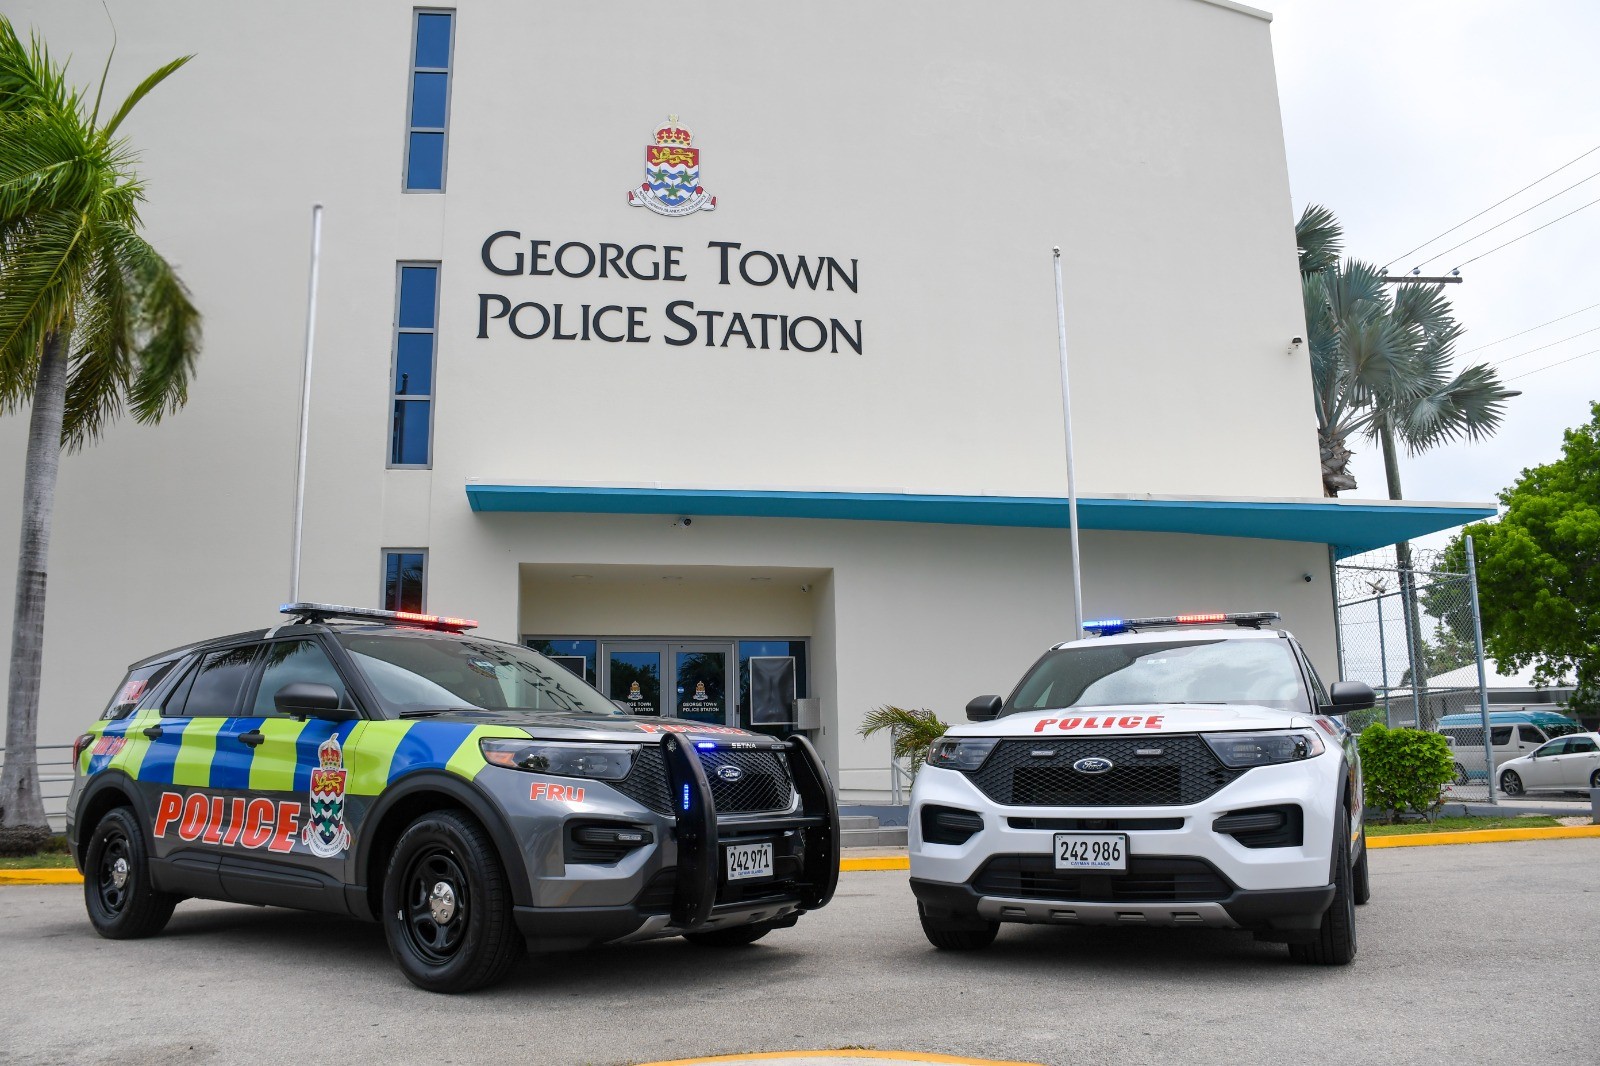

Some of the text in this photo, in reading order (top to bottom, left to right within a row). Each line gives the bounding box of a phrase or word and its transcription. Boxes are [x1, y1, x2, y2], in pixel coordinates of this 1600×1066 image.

[481, 230, 859, 294] GEORGE TOWN
[476, 293, 863, 356] POLICE STATION
[1034, 715, 1165, 733] POLICE
[1081, 760, 1104, 771] Ford
[529, 781, 586, 803] FRU
[153, 792, 302, 853] POLICE
[730, 849, 769, 871] 242 971
[1060, 841, 1121, 862] 242 986
